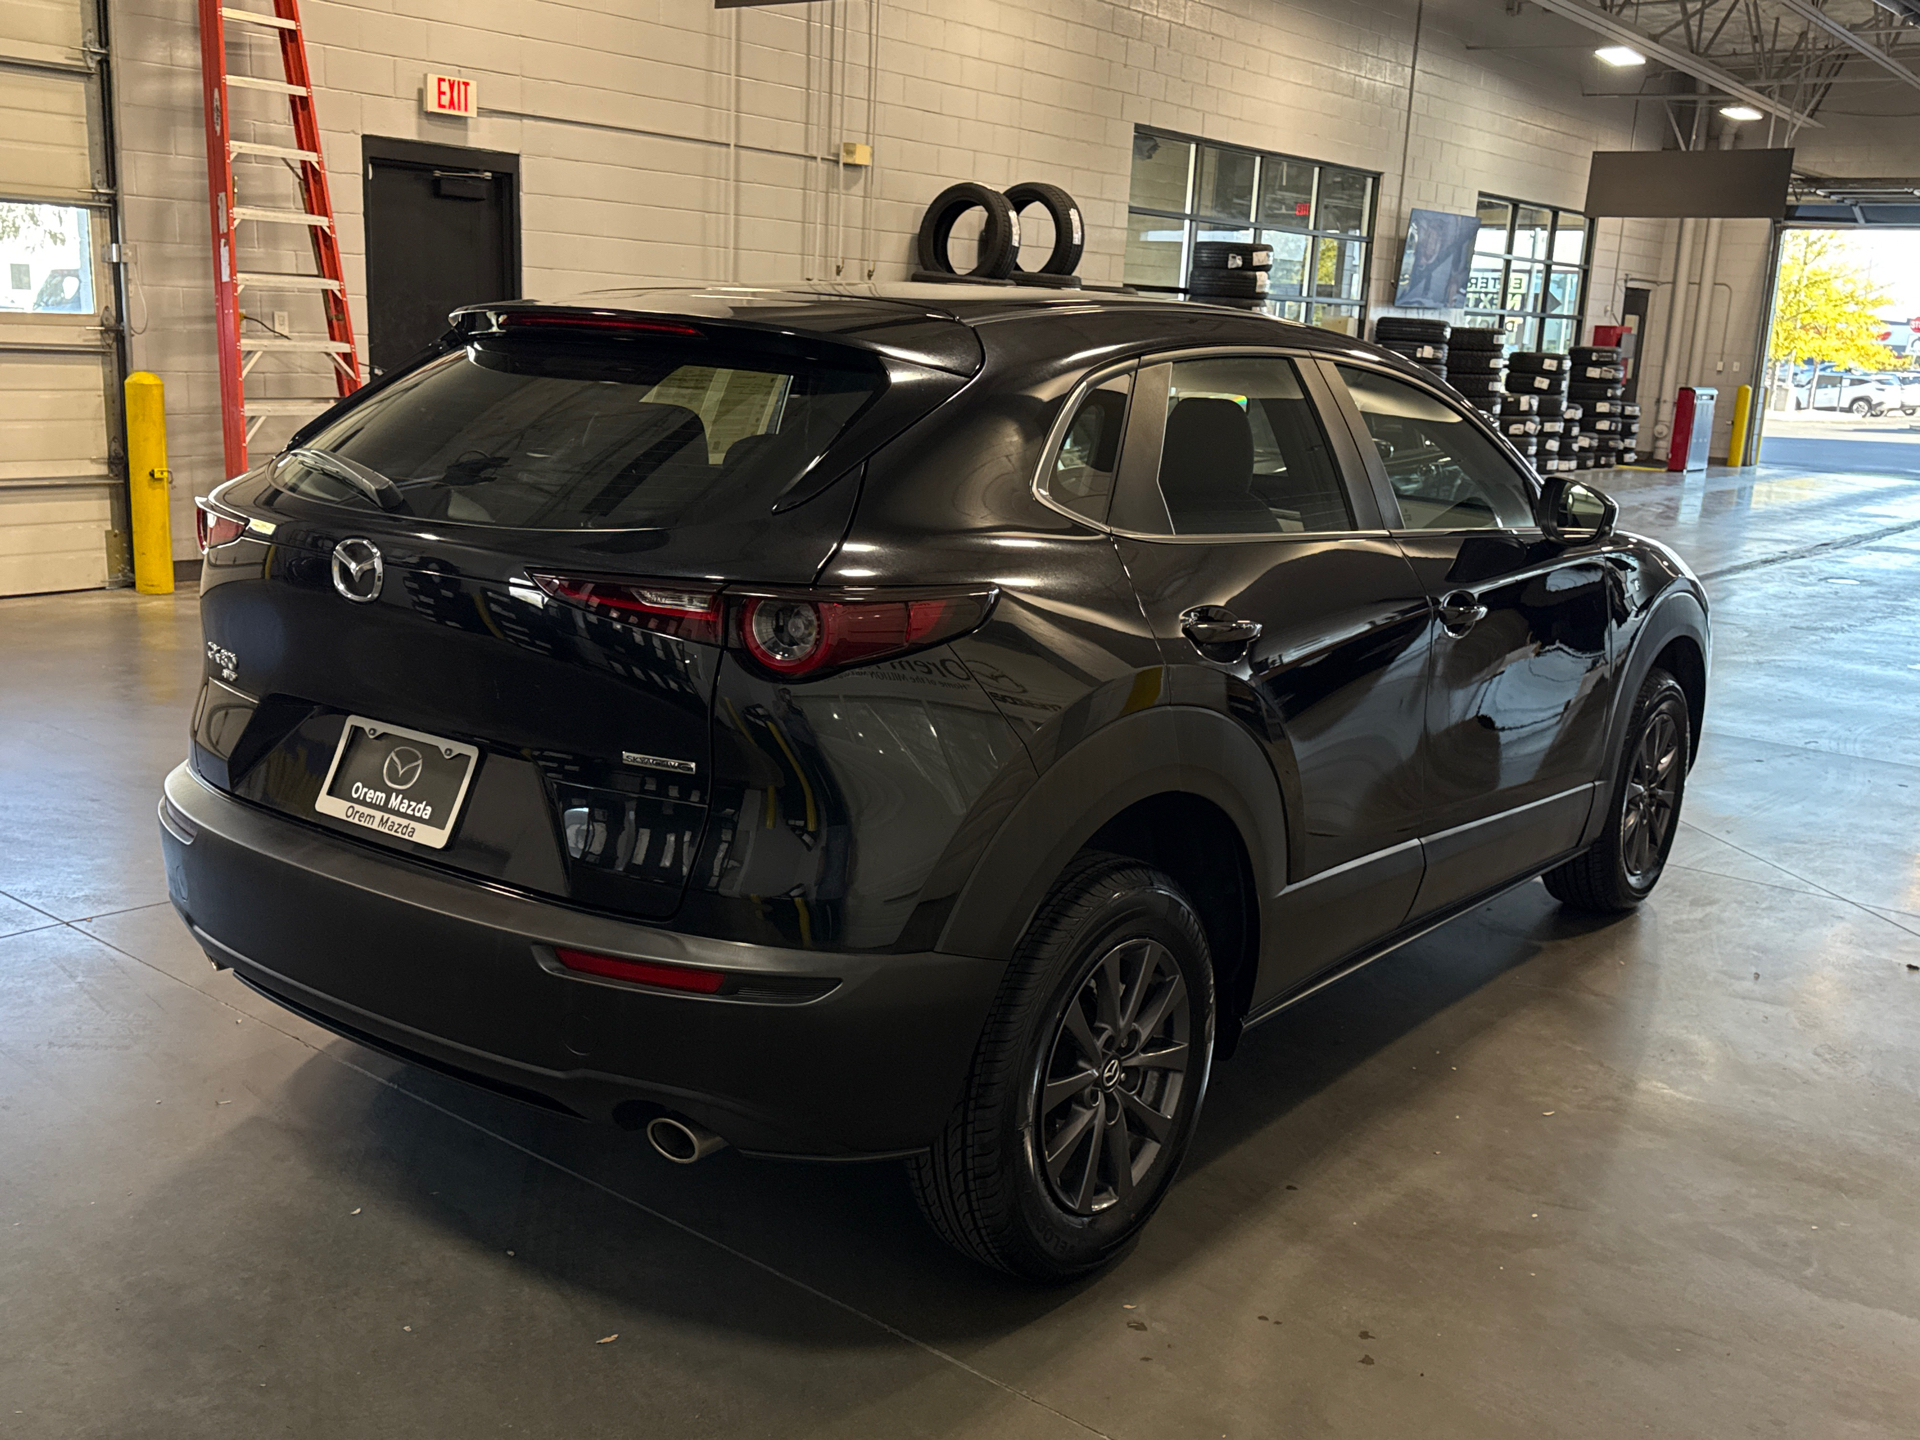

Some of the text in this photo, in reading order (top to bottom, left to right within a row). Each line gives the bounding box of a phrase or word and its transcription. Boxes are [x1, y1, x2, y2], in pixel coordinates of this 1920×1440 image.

[437, 77, 471, 113] EXIT
[1910, 320, 1920, 329] ST
[351, 781, 432, 820] Orem Mazda
[345, 805, 416, 838] Orem Mazda
